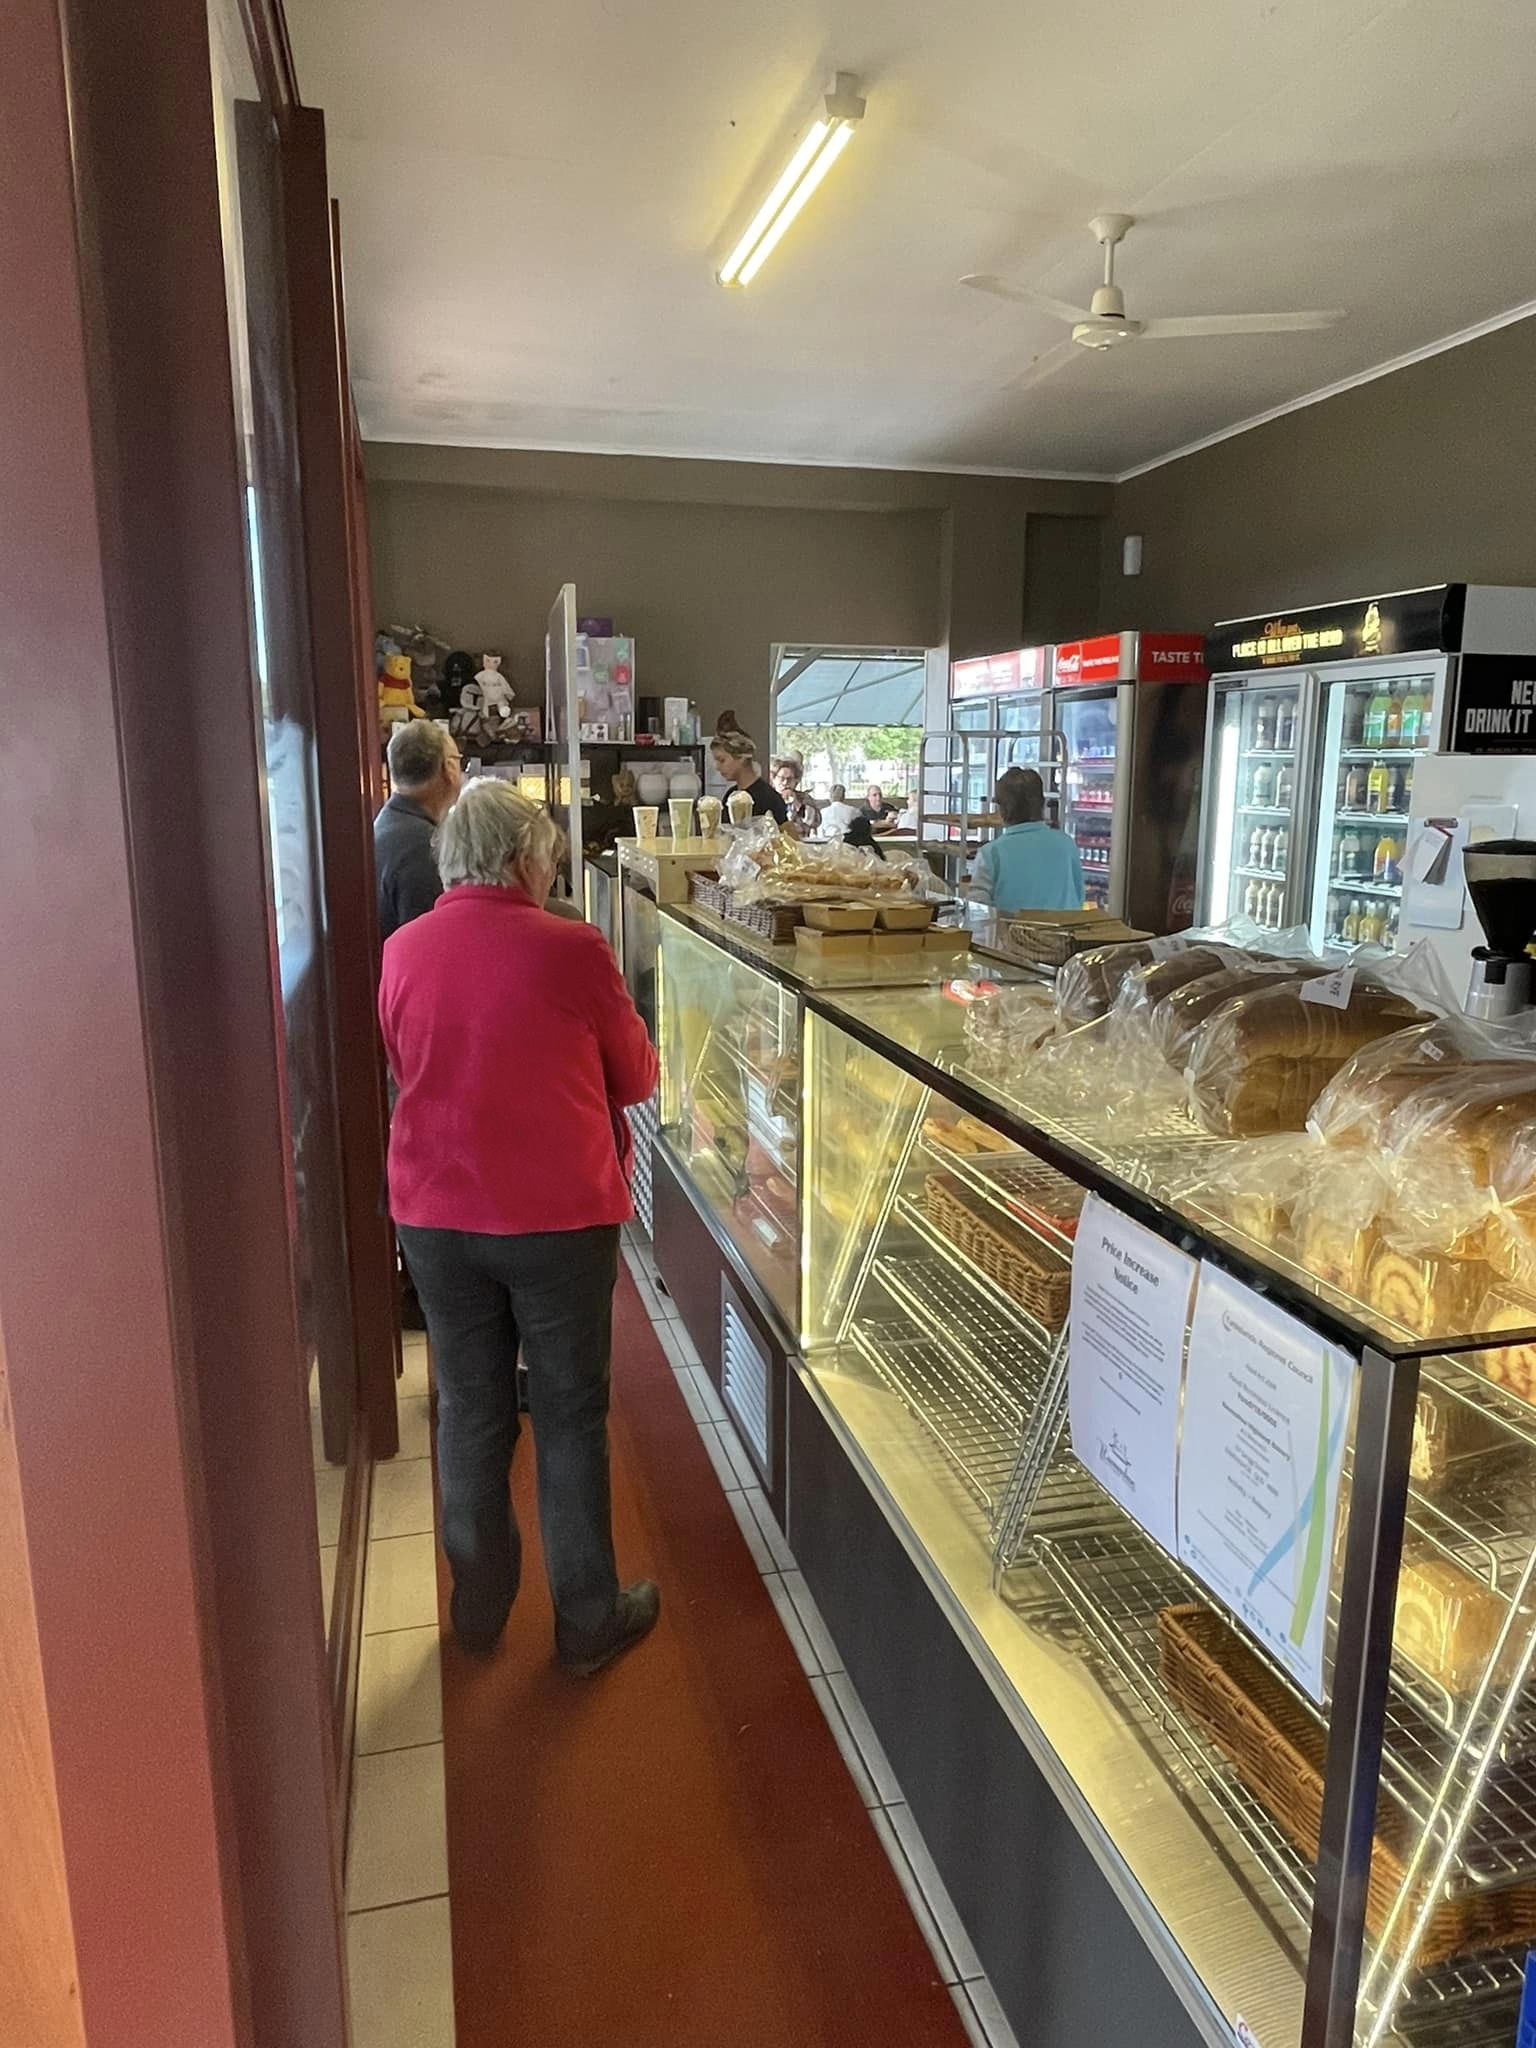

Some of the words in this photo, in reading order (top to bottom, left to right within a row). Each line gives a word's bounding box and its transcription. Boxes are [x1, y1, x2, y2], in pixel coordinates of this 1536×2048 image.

[1153, 651, 1190, 664] TASTE
[1464, 708, 1513, 734] DRINK
[1514, 708, 1533, 734] IT
[1101, 1236, 1123, 1261] Price
[1123, 1251, 1160, 1287] Increase
[1113, 1265, 1139, 1295] Notice
[1287, 1360, 1314, 1385] Council
